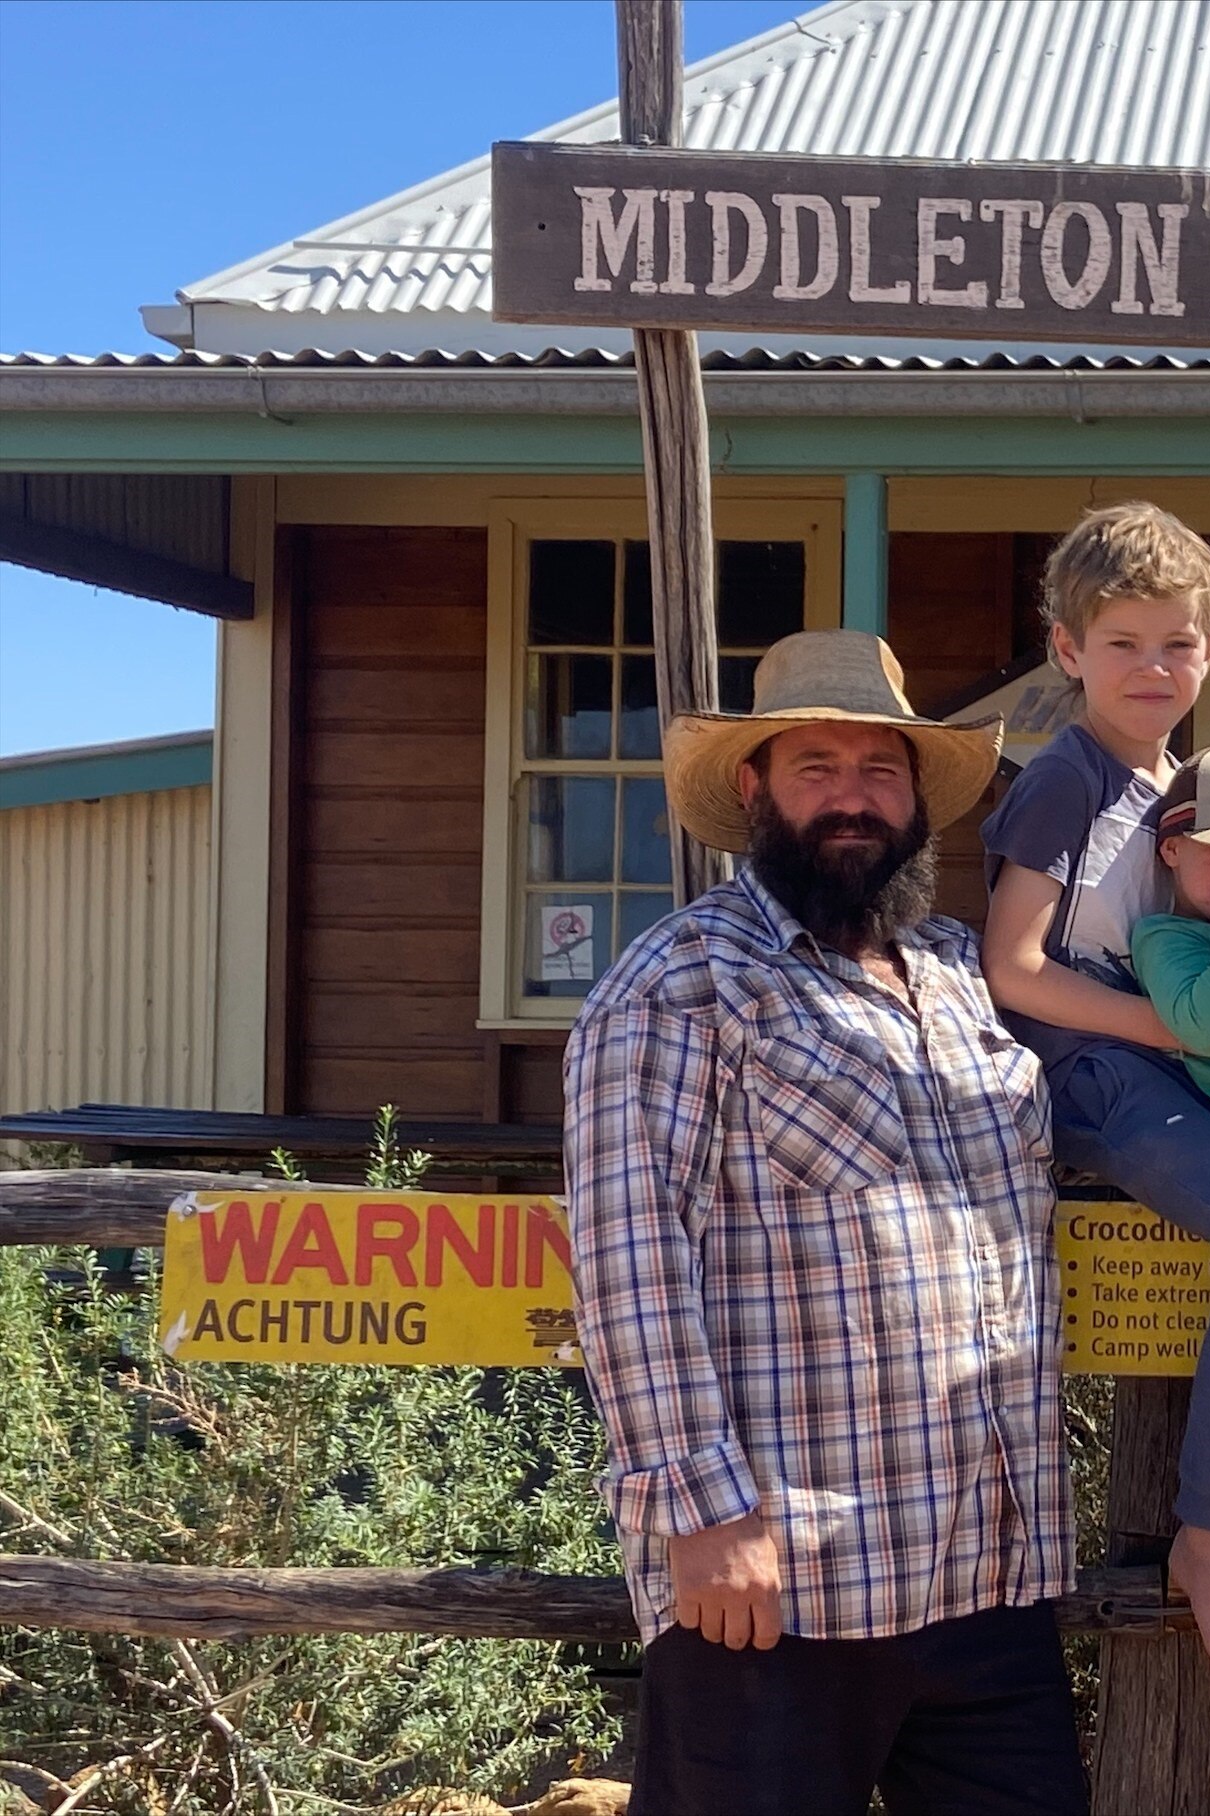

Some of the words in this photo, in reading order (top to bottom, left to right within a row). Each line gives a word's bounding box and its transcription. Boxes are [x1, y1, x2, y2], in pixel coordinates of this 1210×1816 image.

[572, 185, 1188, 318] MIDDLETON
[1092, 1255, 1144, 1280] Keep
[1151, 1260, 1204, 1282] away
[1092, 1283, 1139, 1303] Take
[192, 1299, 427, 1345] ACHTUNG
[1092, 1310, 1119, 1330] Do
[1126, 1313, 1159, 1330] not
[1092, 1337, 1150, 1362] Camp
[1156, 1337, 1199, 1358] well
